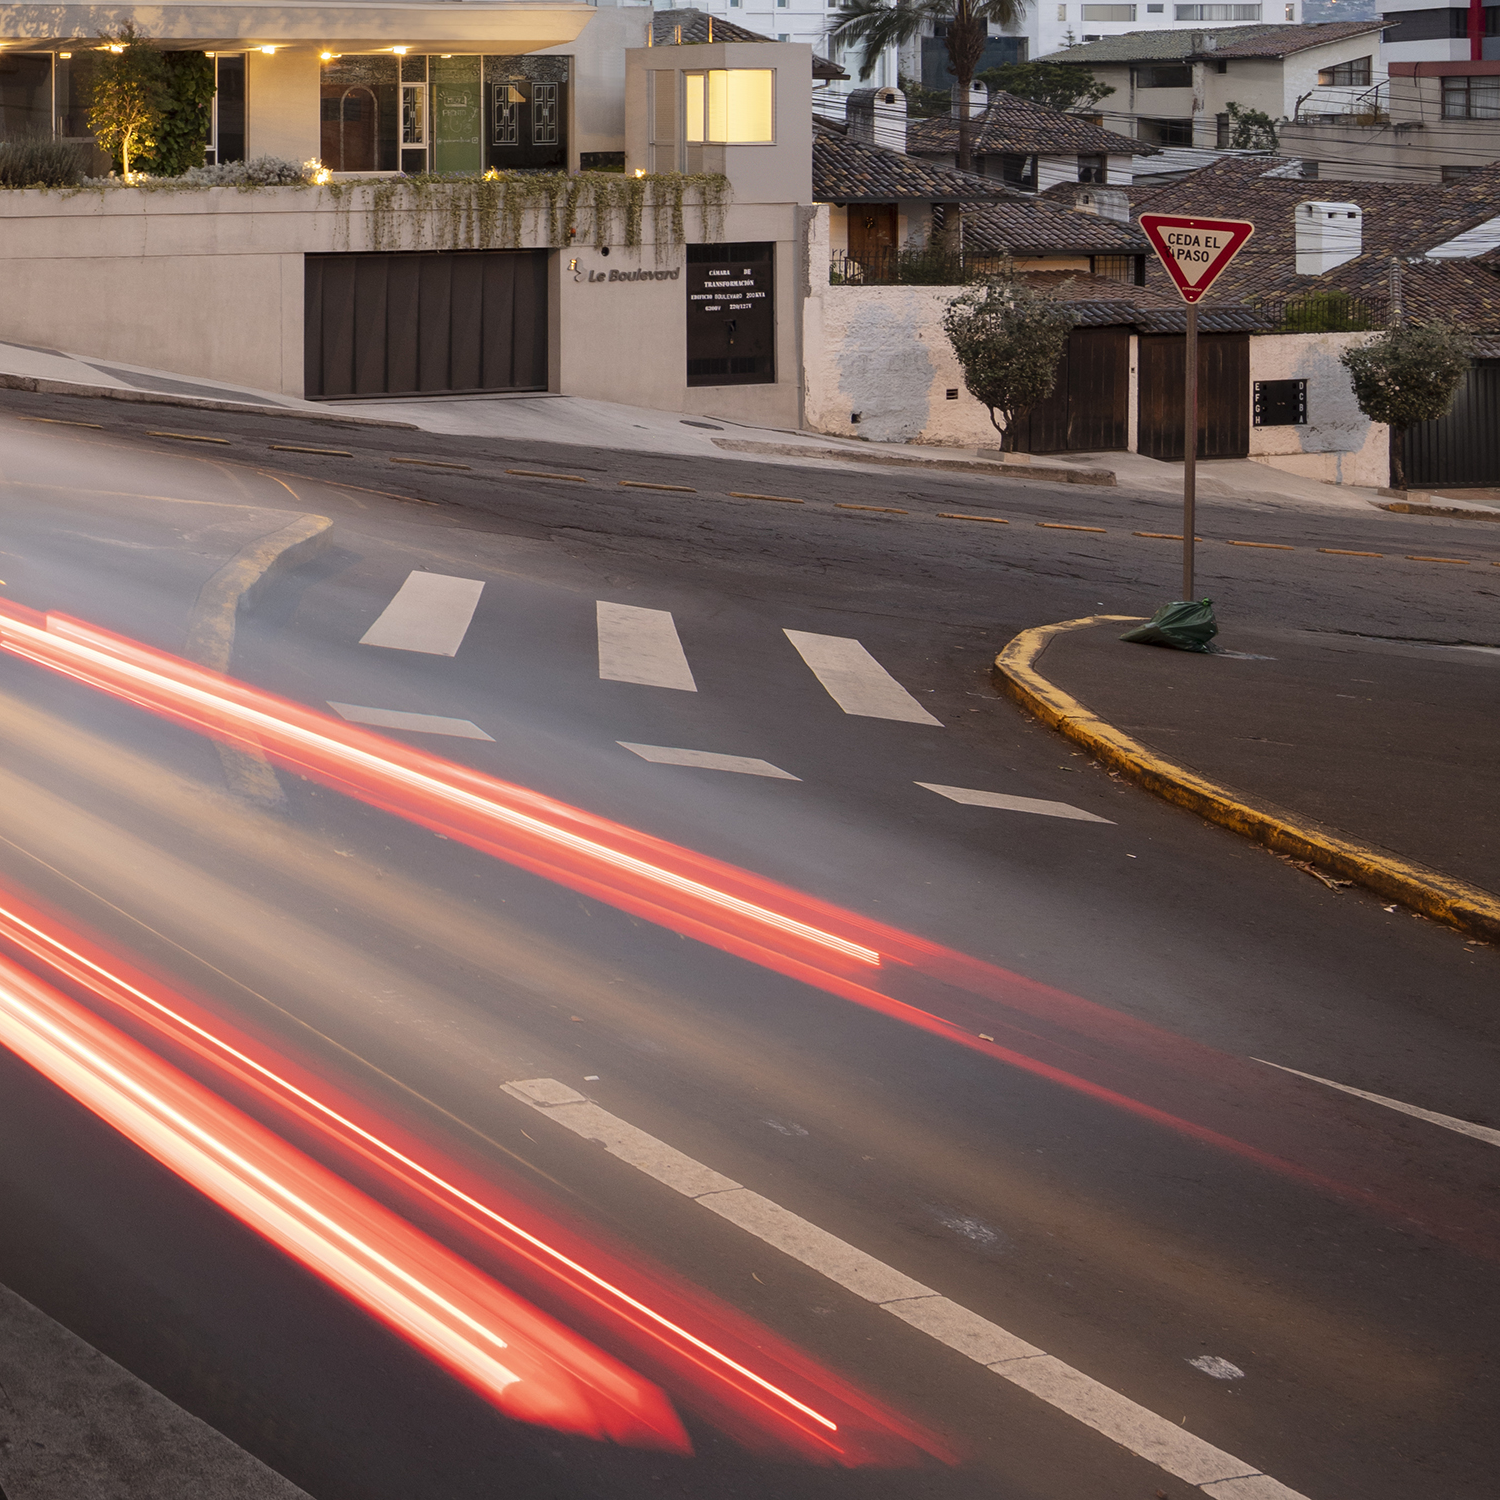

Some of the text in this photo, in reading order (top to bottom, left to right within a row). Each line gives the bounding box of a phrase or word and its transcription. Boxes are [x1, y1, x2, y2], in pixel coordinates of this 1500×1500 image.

[1168, 233, 1221, 249] CEDA EL
[1177, 248, 1209, 262] PASO
[588, 266, 680, 282] Le Boulevard
[704, 279, 754, 288] TRANSFORMACIÓN
[1255, 382, 1260, 391] E
[1299, 381, 1304, 390] D
[1255, 393, 1260, 402] F
[1299, 392, 1304, 401] C
[1255, 404, 1261, 413] G
[1299, 403, 1304, 412] B
[1255, 415, 1261, 424] H
[1299, 415, 1304, 423] A
